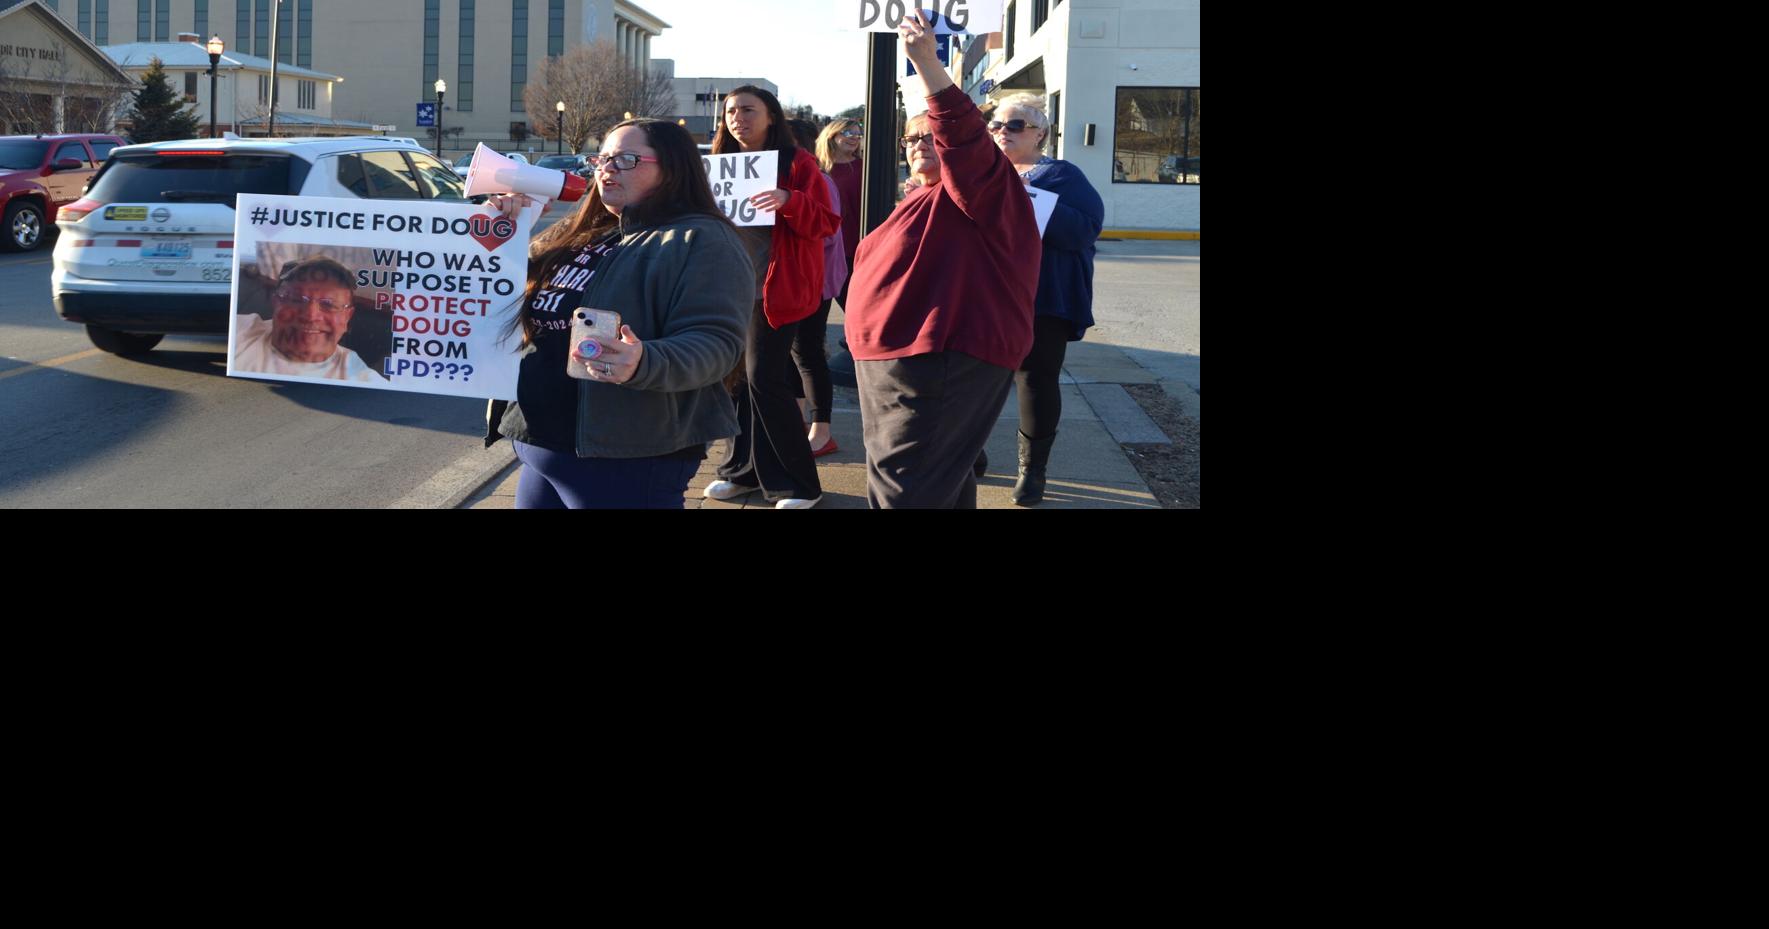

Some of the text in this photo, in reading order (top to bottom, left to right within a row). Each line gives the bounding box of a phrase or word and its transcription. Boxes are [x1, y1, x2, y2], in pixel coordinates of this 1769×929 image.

[859, 0, 969, 31] DOUG
[16, 46, 36, 59] CITY
[251, 206, 514, 238] #JUSTICE FOR DOUG
[373, 249, 501, 273] WHO WAS
[357, 269, 514, 296] SUPPOSE TO
[375, 292, 491, 317] PROTECT
[531, 290, 566, 313] 511
[392, 315, 471, 337] DOUG
[392, 337, 468, 359] FROM
[384, 357, 474, 382] LPD???
